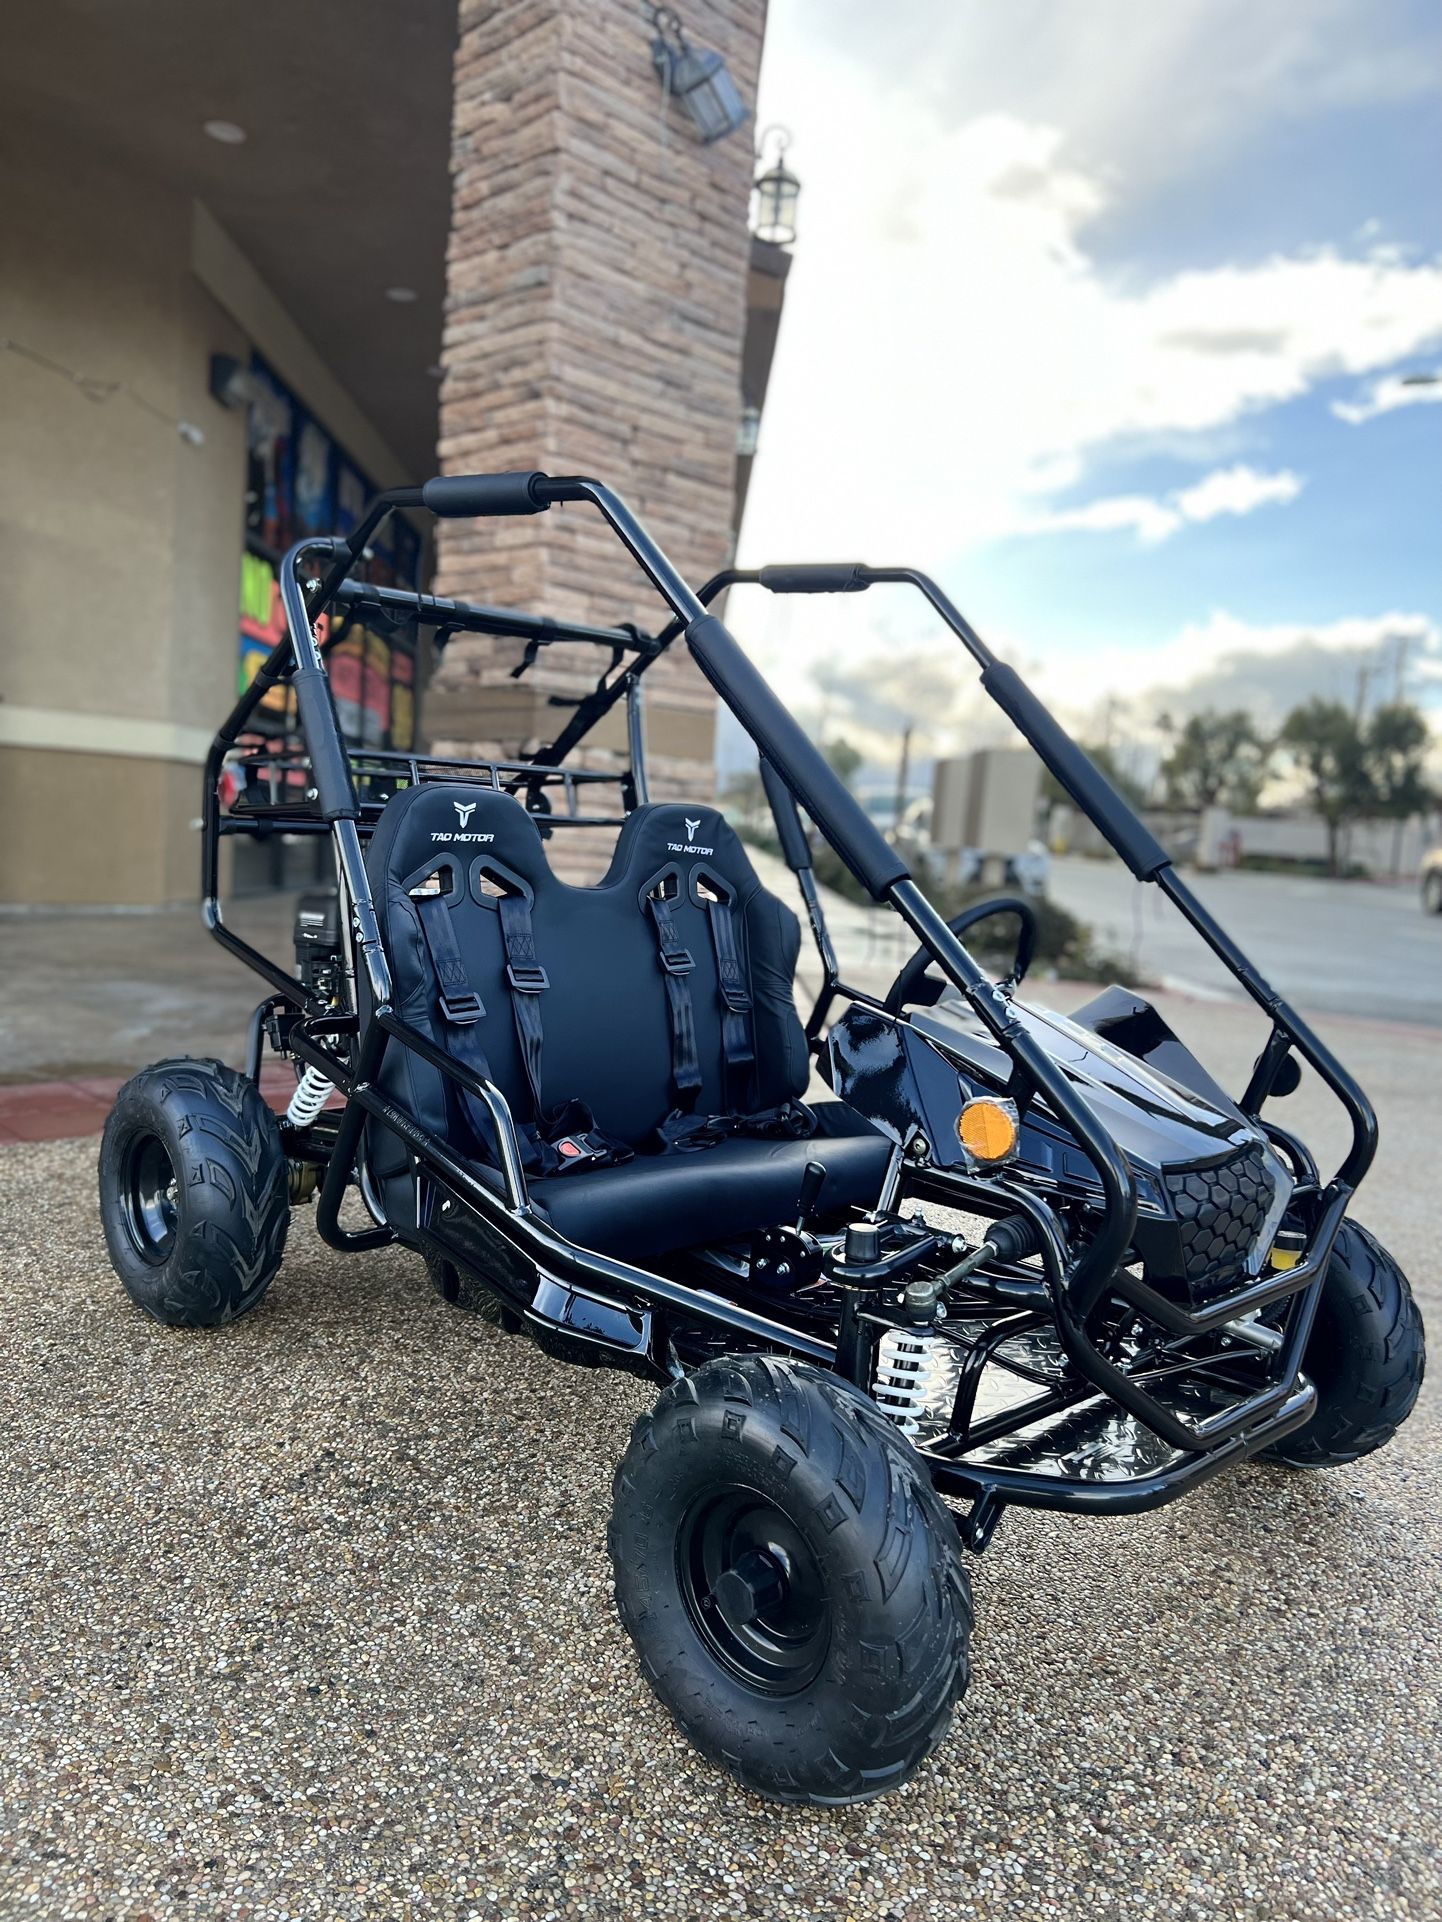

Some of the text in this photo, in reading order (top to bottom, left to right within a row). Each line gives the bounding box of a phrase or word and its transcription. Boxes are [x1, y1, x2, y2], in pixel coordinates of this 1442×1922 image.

[430, 832, 495, 843] TAO MOTOR
[667, 842, 714, 856] TAO MOTOR
